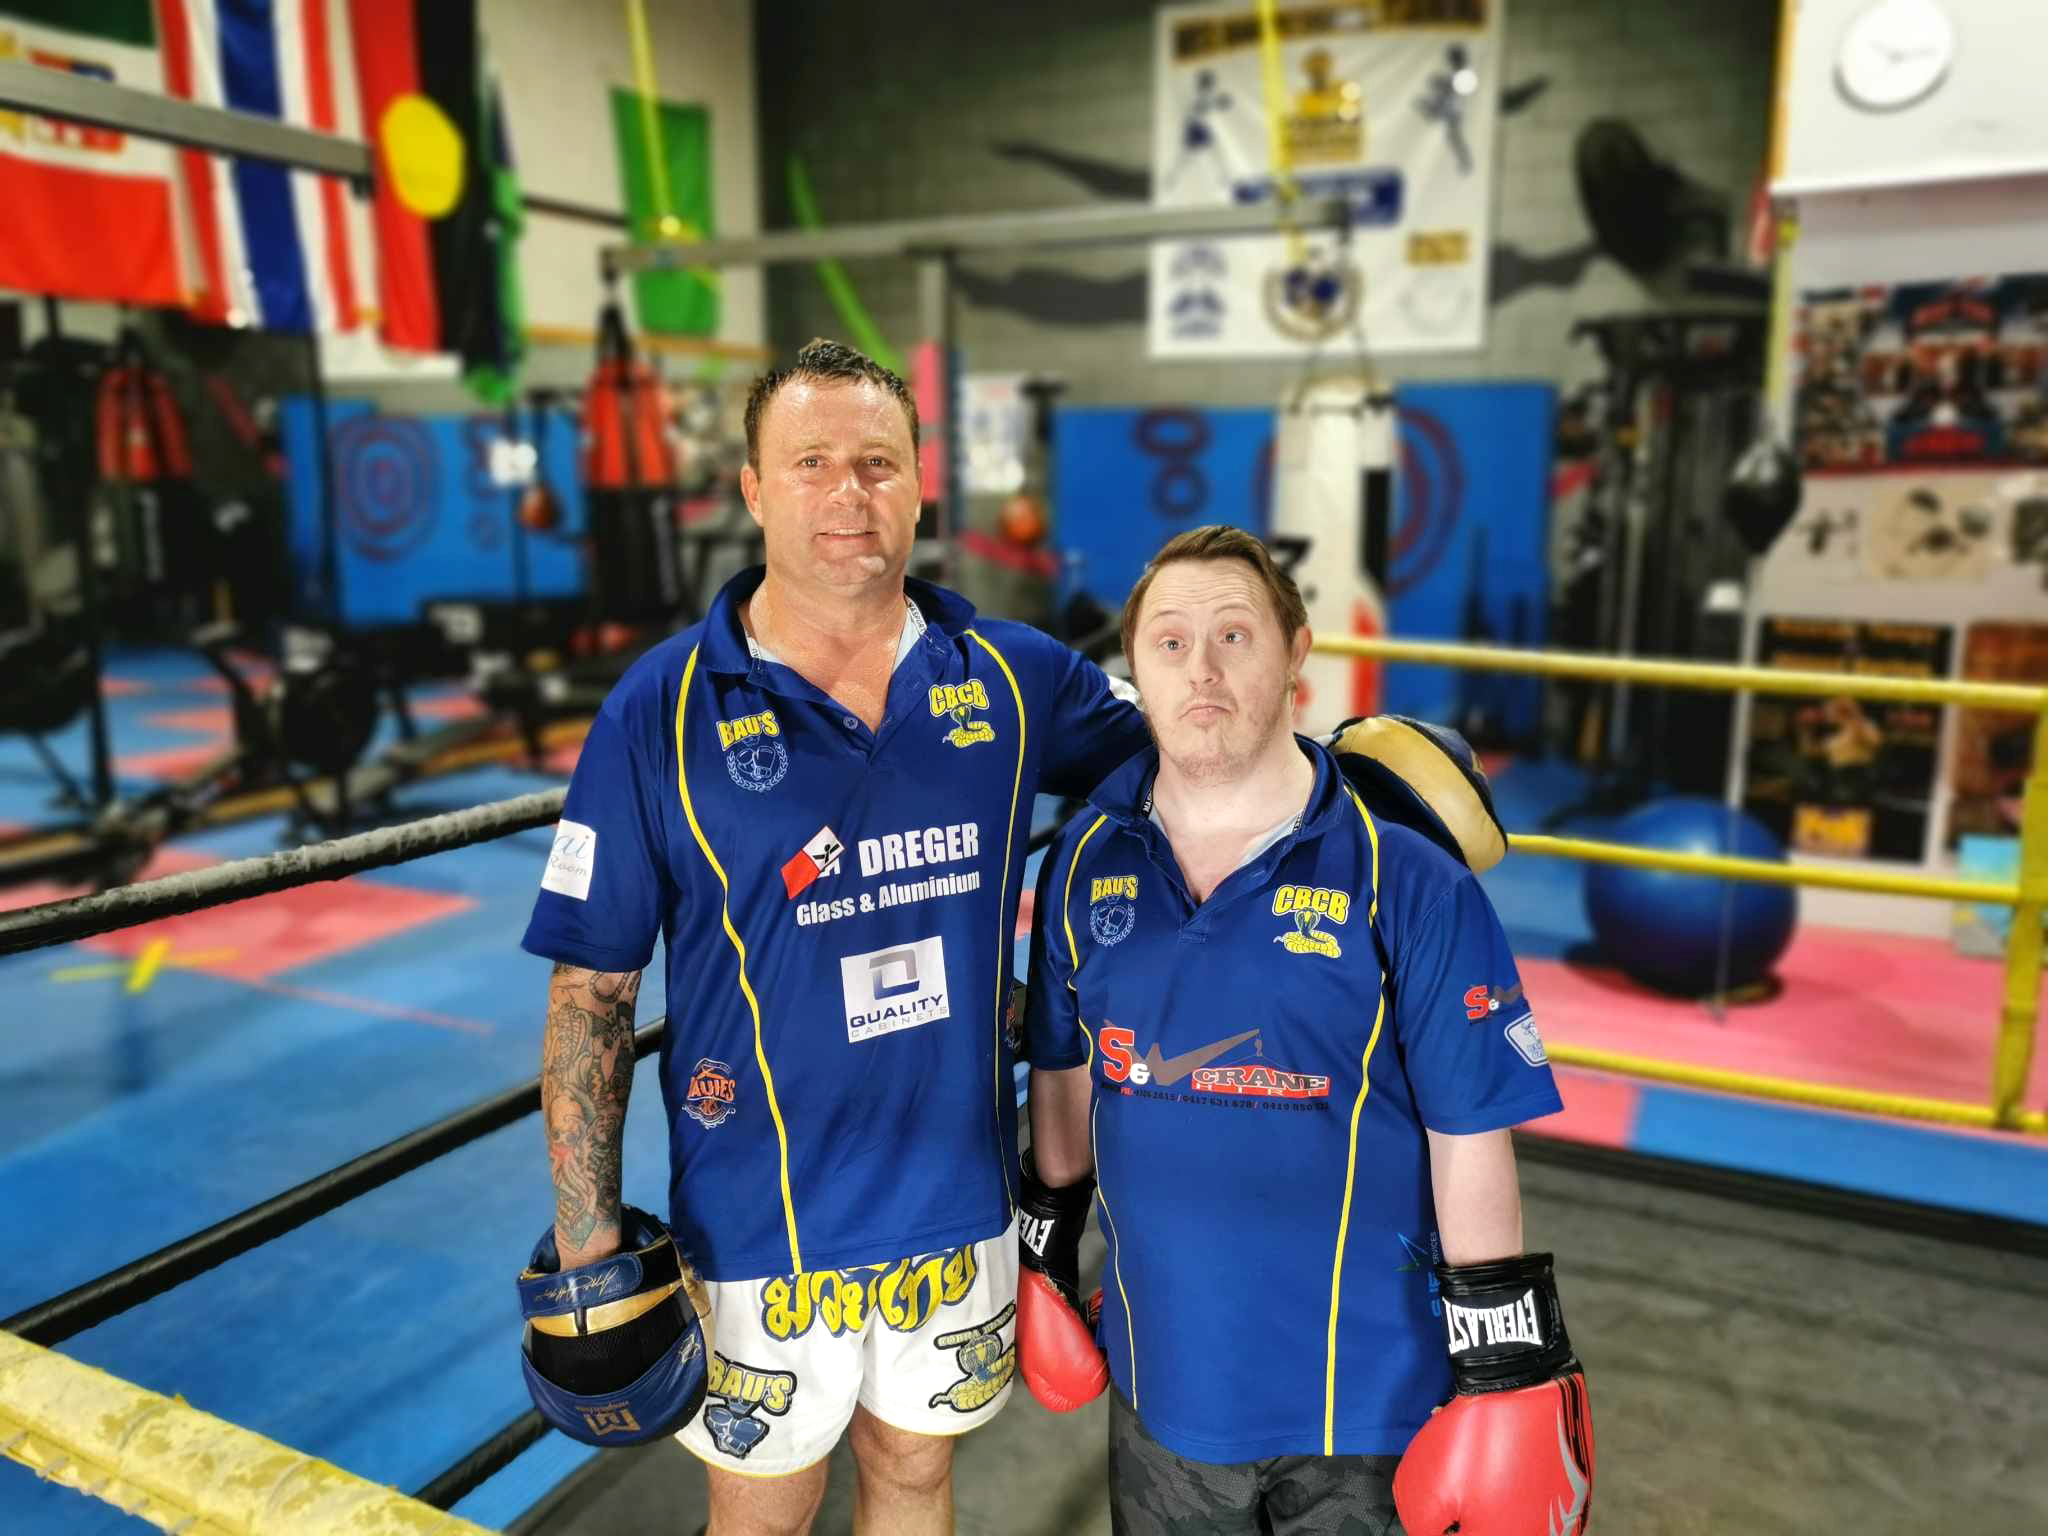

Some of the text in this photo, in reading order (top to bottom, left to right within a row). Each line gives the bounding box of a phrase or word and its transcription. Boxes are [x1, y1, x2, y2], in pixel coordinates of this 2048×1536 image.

[716, 709, 780, 751] BAU'S
[858, 822, 979, 878] DREGER
[796, 870, 980, 927] Glass & Aluminium
[1090, 875, 1138, 905] BAU'S
[1272, 885, 1350, 925] CBCB
[850, 993, 944, 1028] QUALITY
[851, 1006, 948, 1038] CABINETS
[1192, 1066, 1329, 1092] CRANE
[1442, 1288, 1543, 1355] EVERLAST
